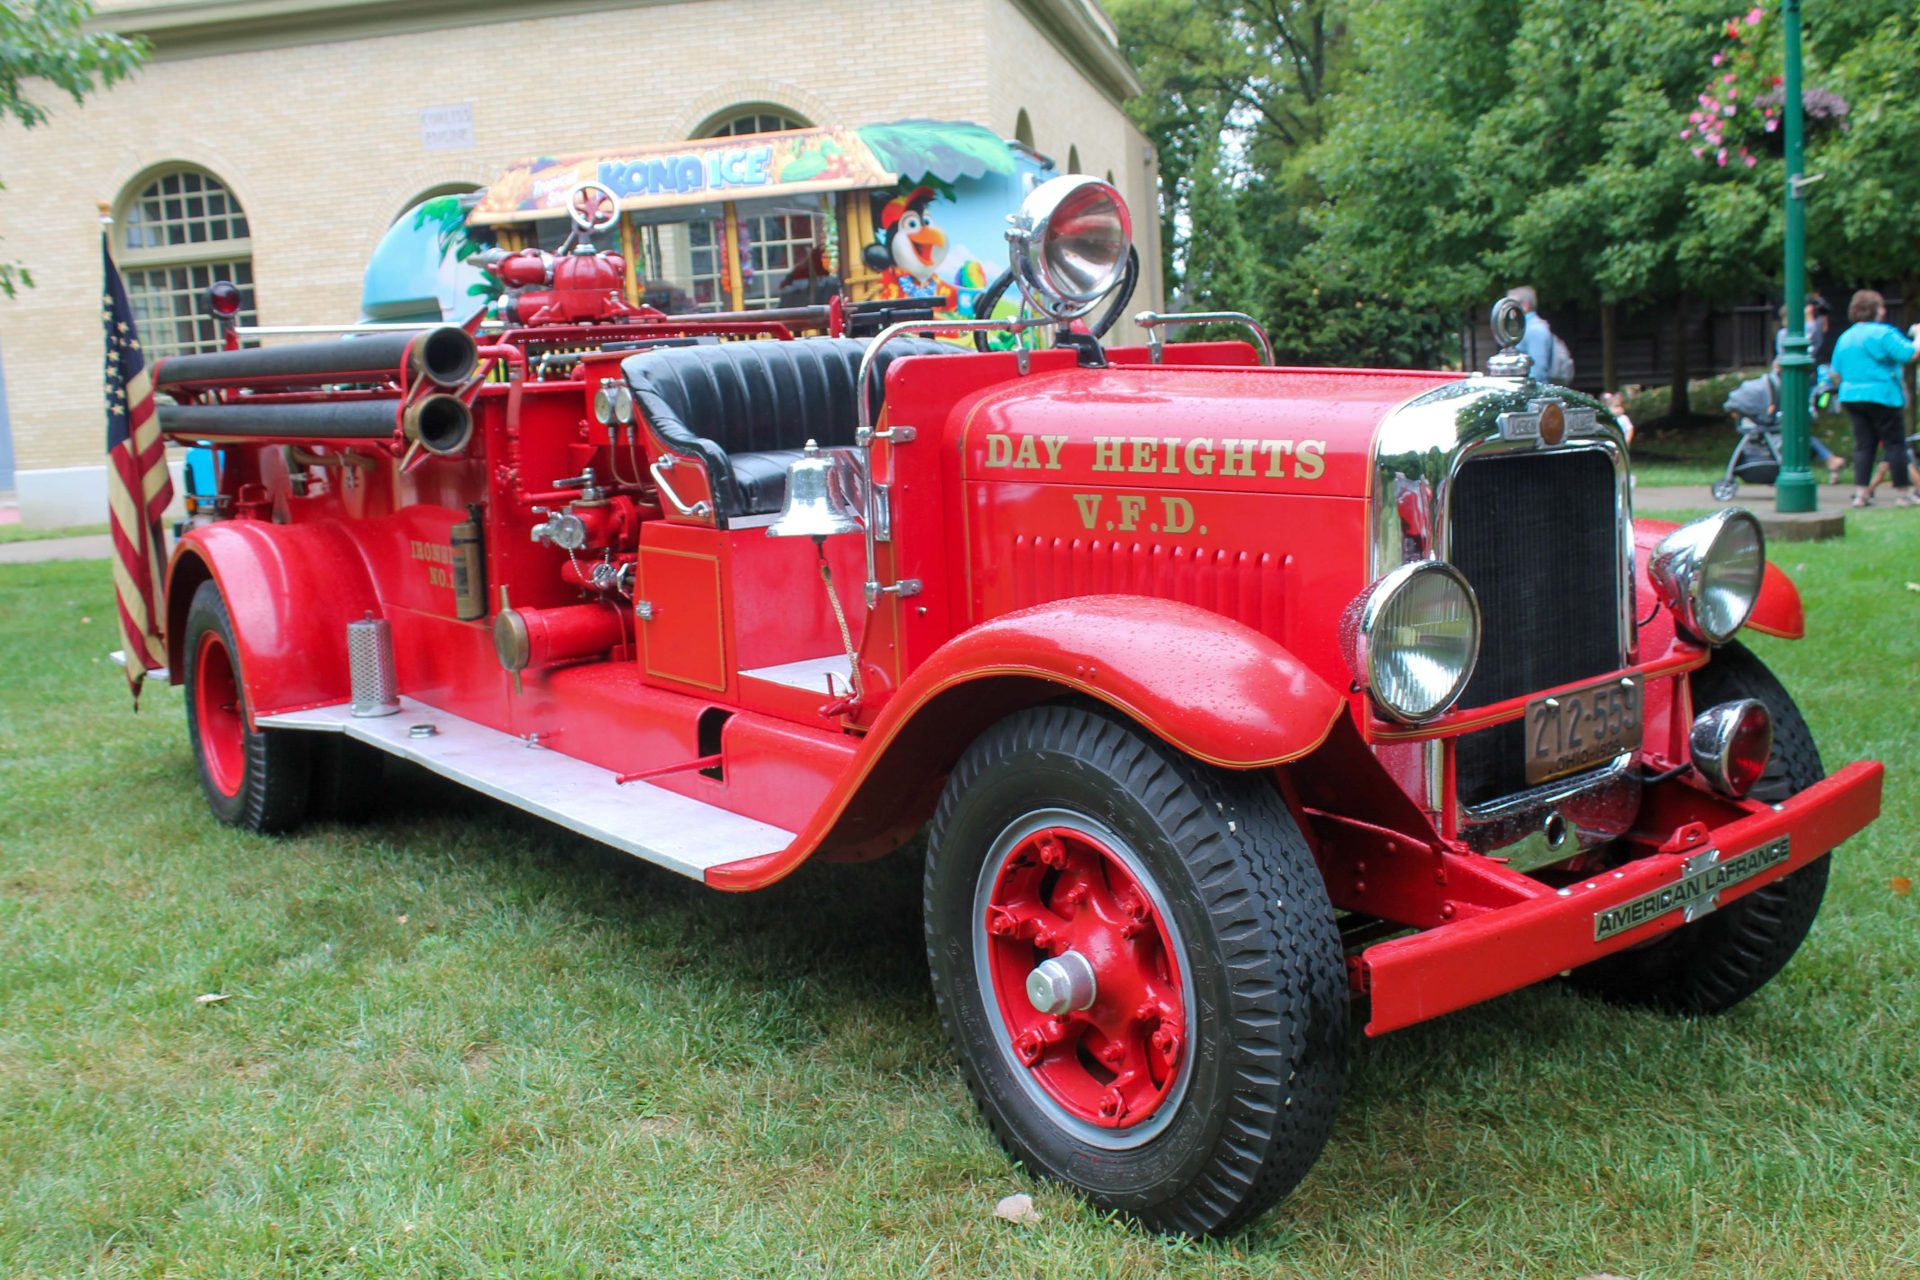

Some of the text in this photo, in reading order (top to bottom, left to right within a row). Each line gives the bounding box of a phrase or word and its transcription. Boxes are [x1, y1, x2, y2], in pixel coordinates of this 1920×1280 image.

[597, 154, 706, 199] KONA
[707, 145, 772, 188] ICE
[985, 434, 1327, 480] DAY HEIGHTS
[1073, 494, 1208, 535] V.F.D.
[1533, 684, 1637, 759] 212-559
[1597, 838, 1790, 936] AMERICAN LAFRANCE
